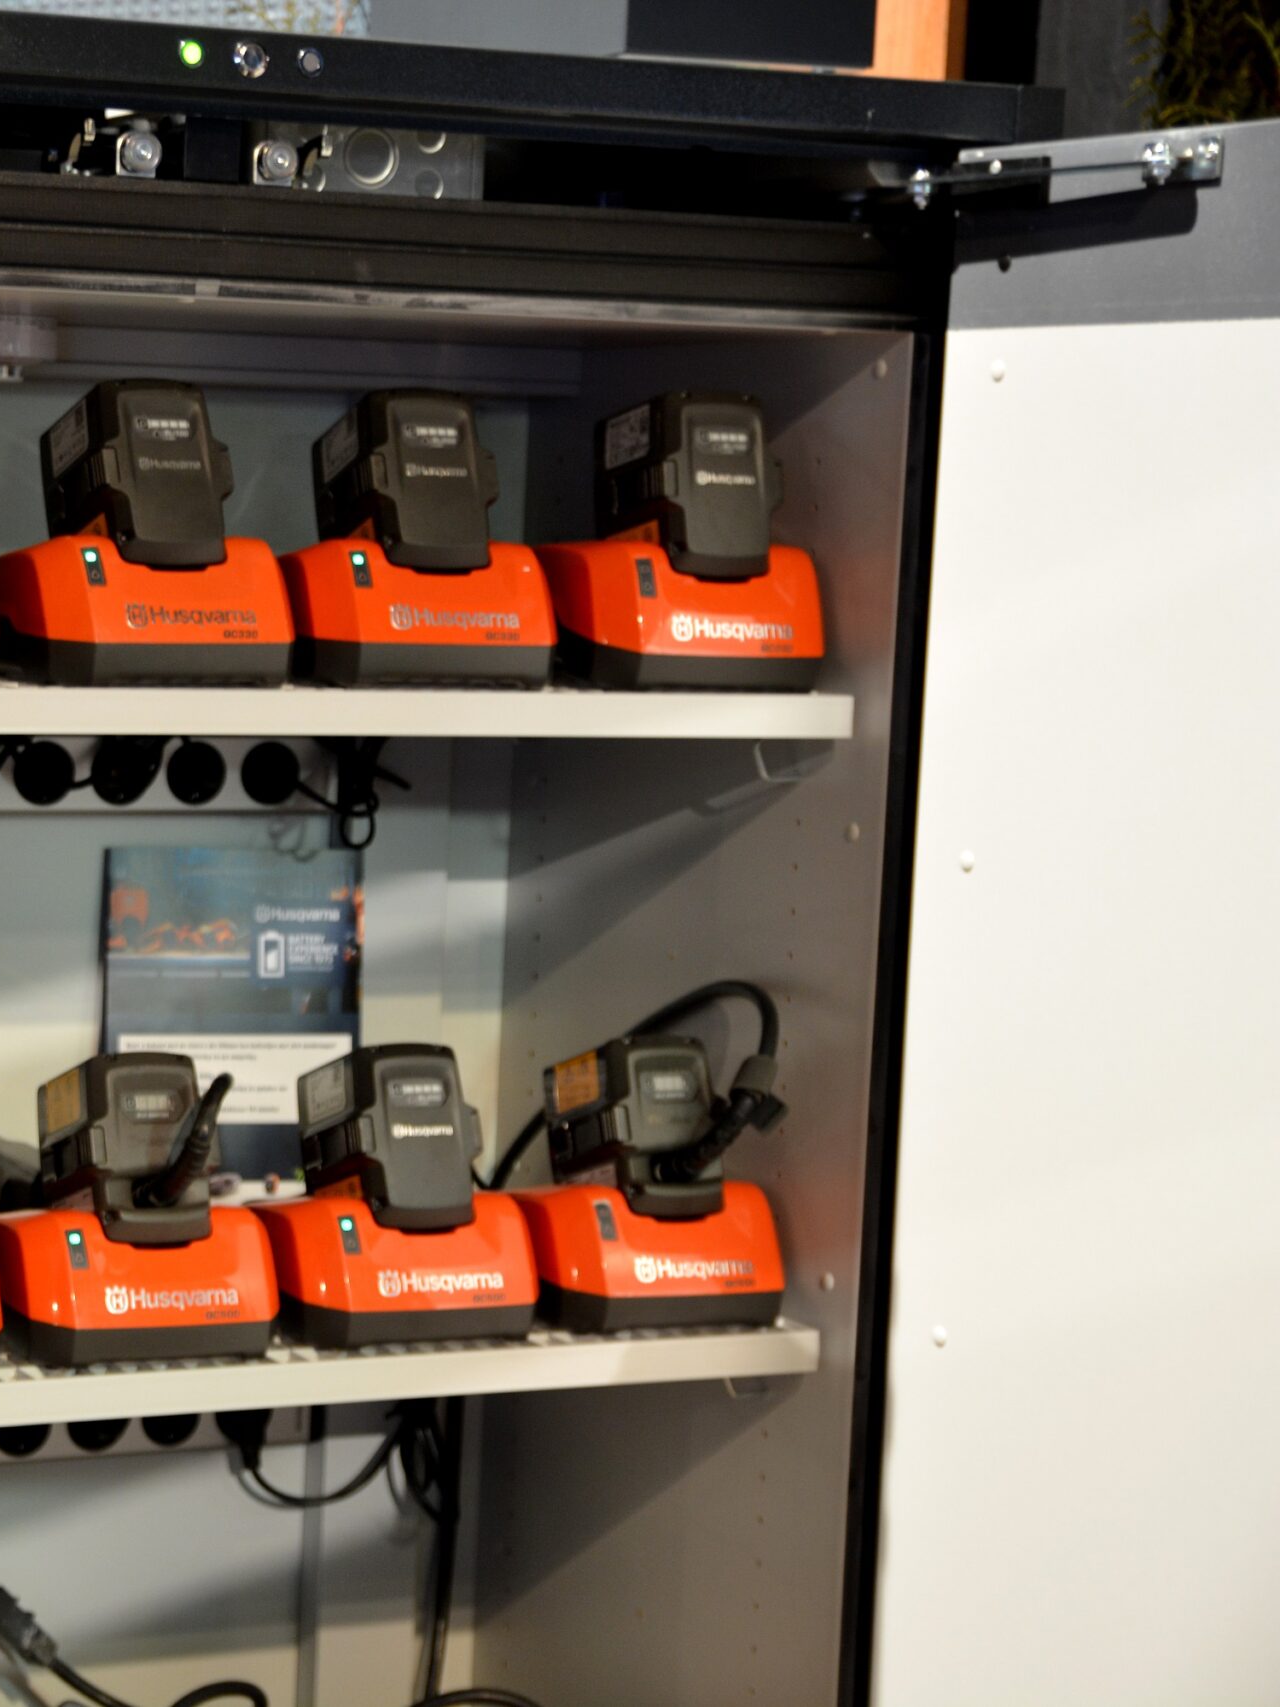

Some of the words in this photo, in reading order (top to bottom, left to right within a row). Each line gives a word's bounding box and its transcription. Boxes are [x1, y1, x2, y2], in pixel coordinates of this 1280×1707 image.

[150, 458, 201, 471] Husqvarna
[149, 605, 257, 628] Husqvarna
[414, 607, 520, 630] Husqvarna
[694, 617, 794, 642] Husqvarna
[271, 907, 341, 923] Husqvarna
[401, 1124, 454, 1138] Husqvarna
[656, 1257, 754, 1280] Husqvarna
[402, 1271, 504, 1294] Husqvarna
[129, 1287, 239, 1311] Husqvarna
